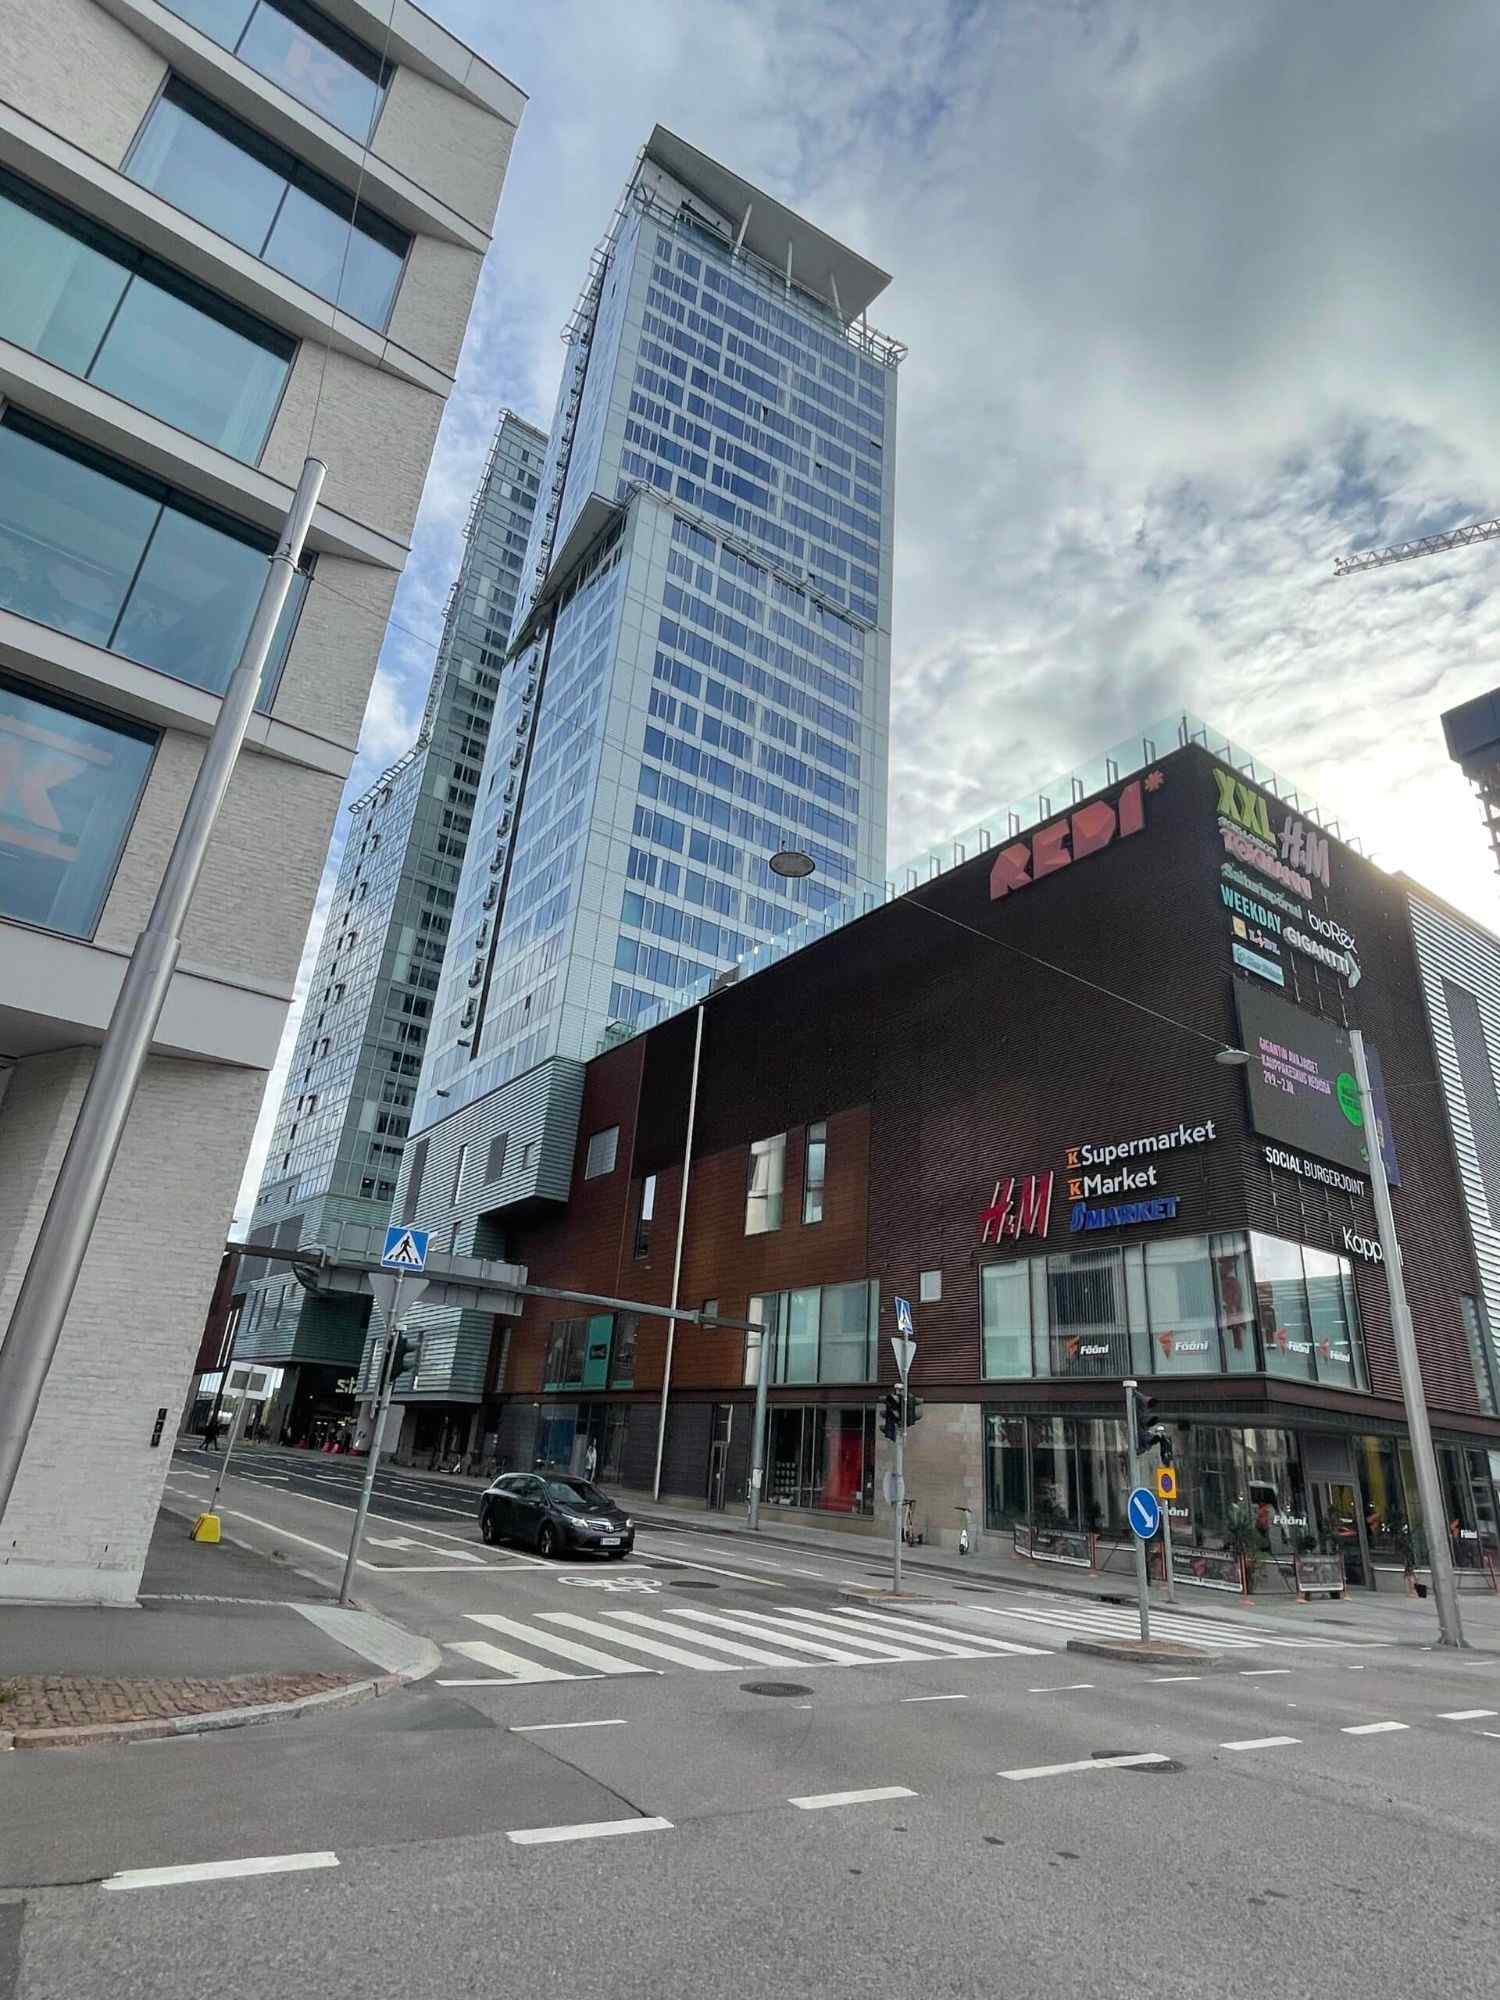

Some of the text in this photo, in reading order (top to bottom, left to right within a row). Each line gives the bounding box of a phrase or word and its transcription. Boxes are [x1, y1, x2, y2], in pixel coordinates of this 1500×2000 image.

[1213, 768, 1277, 847] XXL
[990, 780, 1144, 900] REDI
[1278, 816, 1330, 889] H&M
[1220, 883, 1281, 935] WEEKDAY
[1283, 927, 1350, 976] GIGANTTI
[1081, 1119, 1216, 1166] Supermarket
[1083, 1165, 1157, 1198] Market
[1265, 1146, 1364, 1198] SOCIAL BURGERJOINT
[977, 1168, 1054, 1244] H&M
